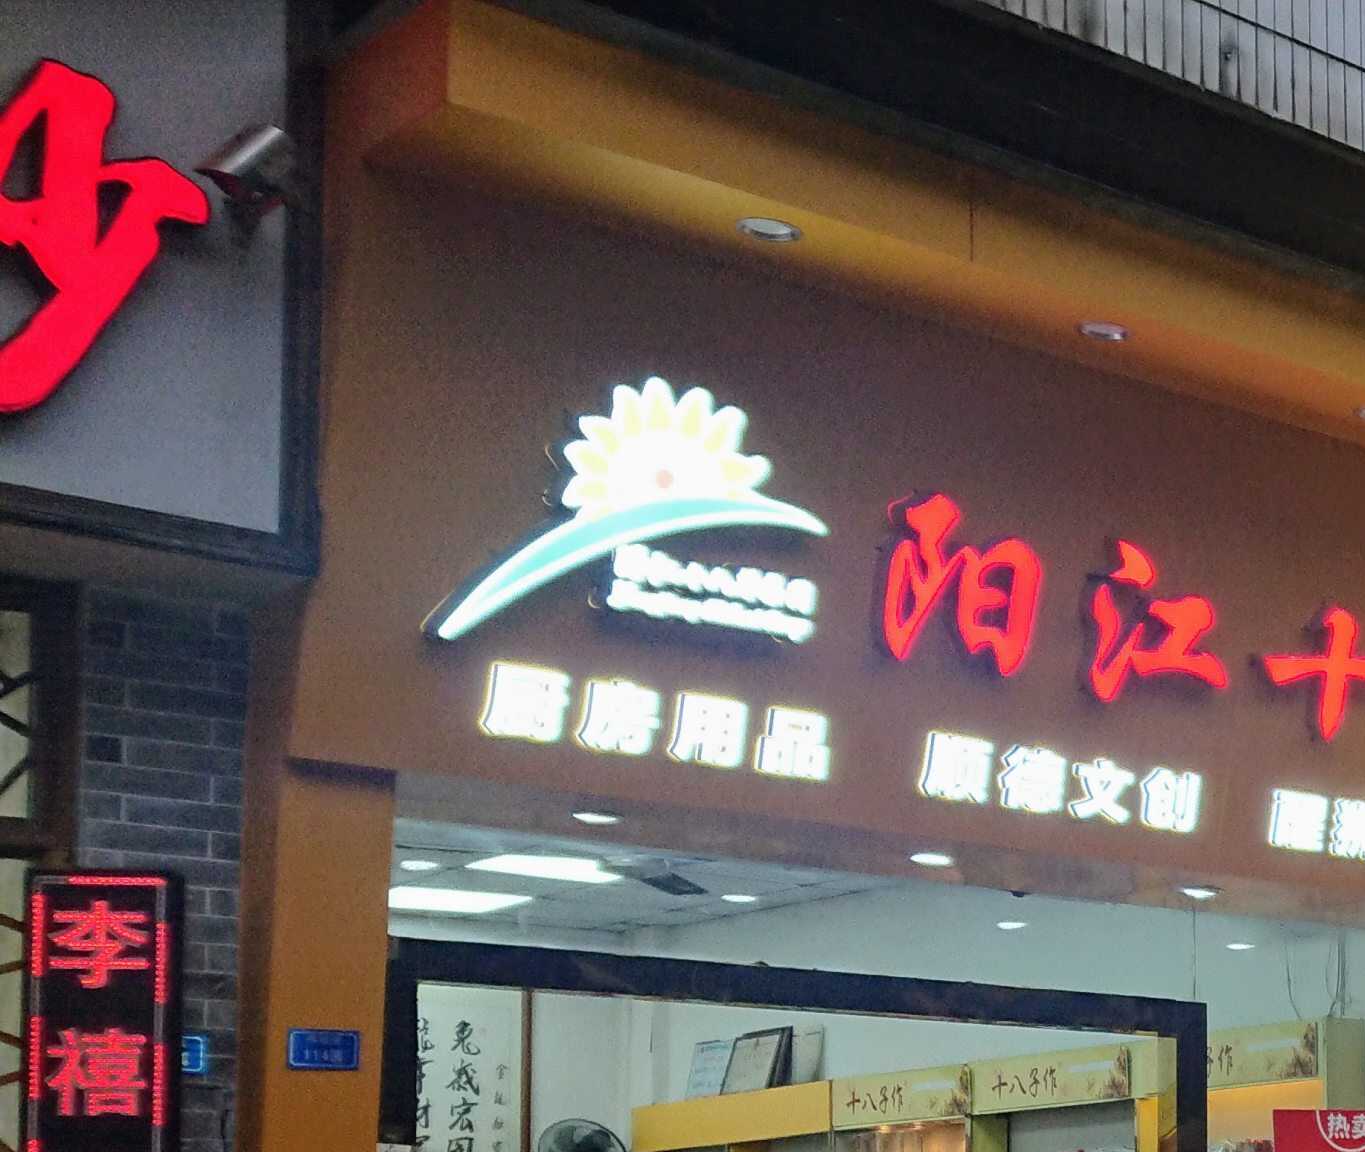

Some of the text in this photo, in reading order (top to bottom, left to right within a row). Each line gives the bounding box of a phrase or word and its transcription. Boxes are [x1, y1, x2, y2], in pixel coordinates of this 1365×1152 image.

[919, 731, 1202, 833] 顺德文创
[846, 1081, 905, 1115] 十八子作
[991, 1066, 1058, 1099] 十八子作
